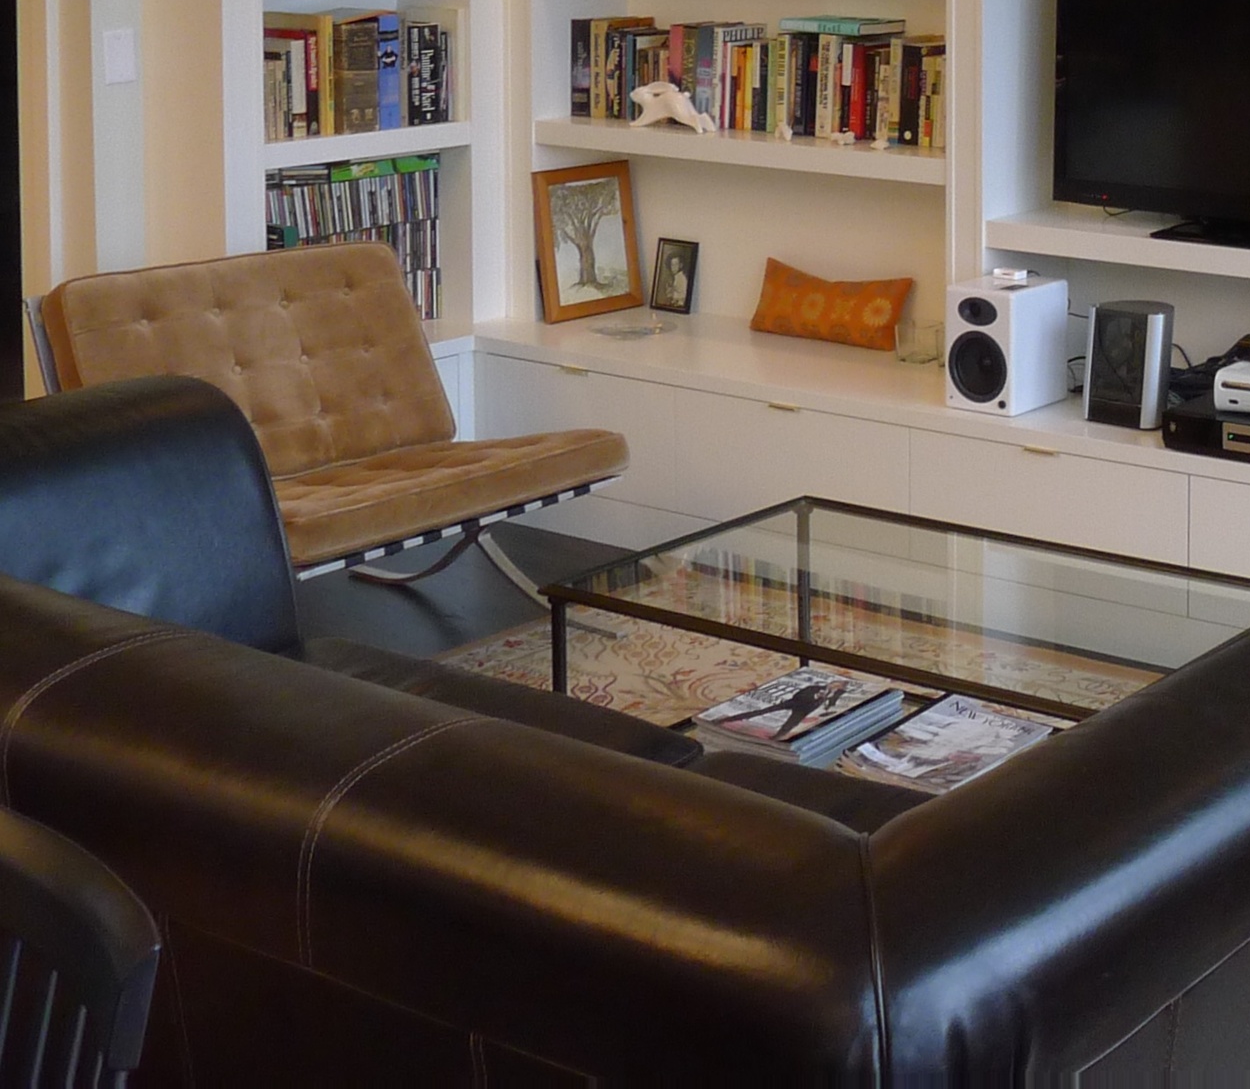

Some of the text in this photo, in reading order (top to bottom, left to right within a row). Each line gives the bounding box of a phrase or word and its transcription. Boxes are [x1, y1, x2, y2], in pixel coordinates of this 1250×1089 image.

[723, 27, 764, 43] PHILIP
[420, 49, 436, 111] Pauline Kael
